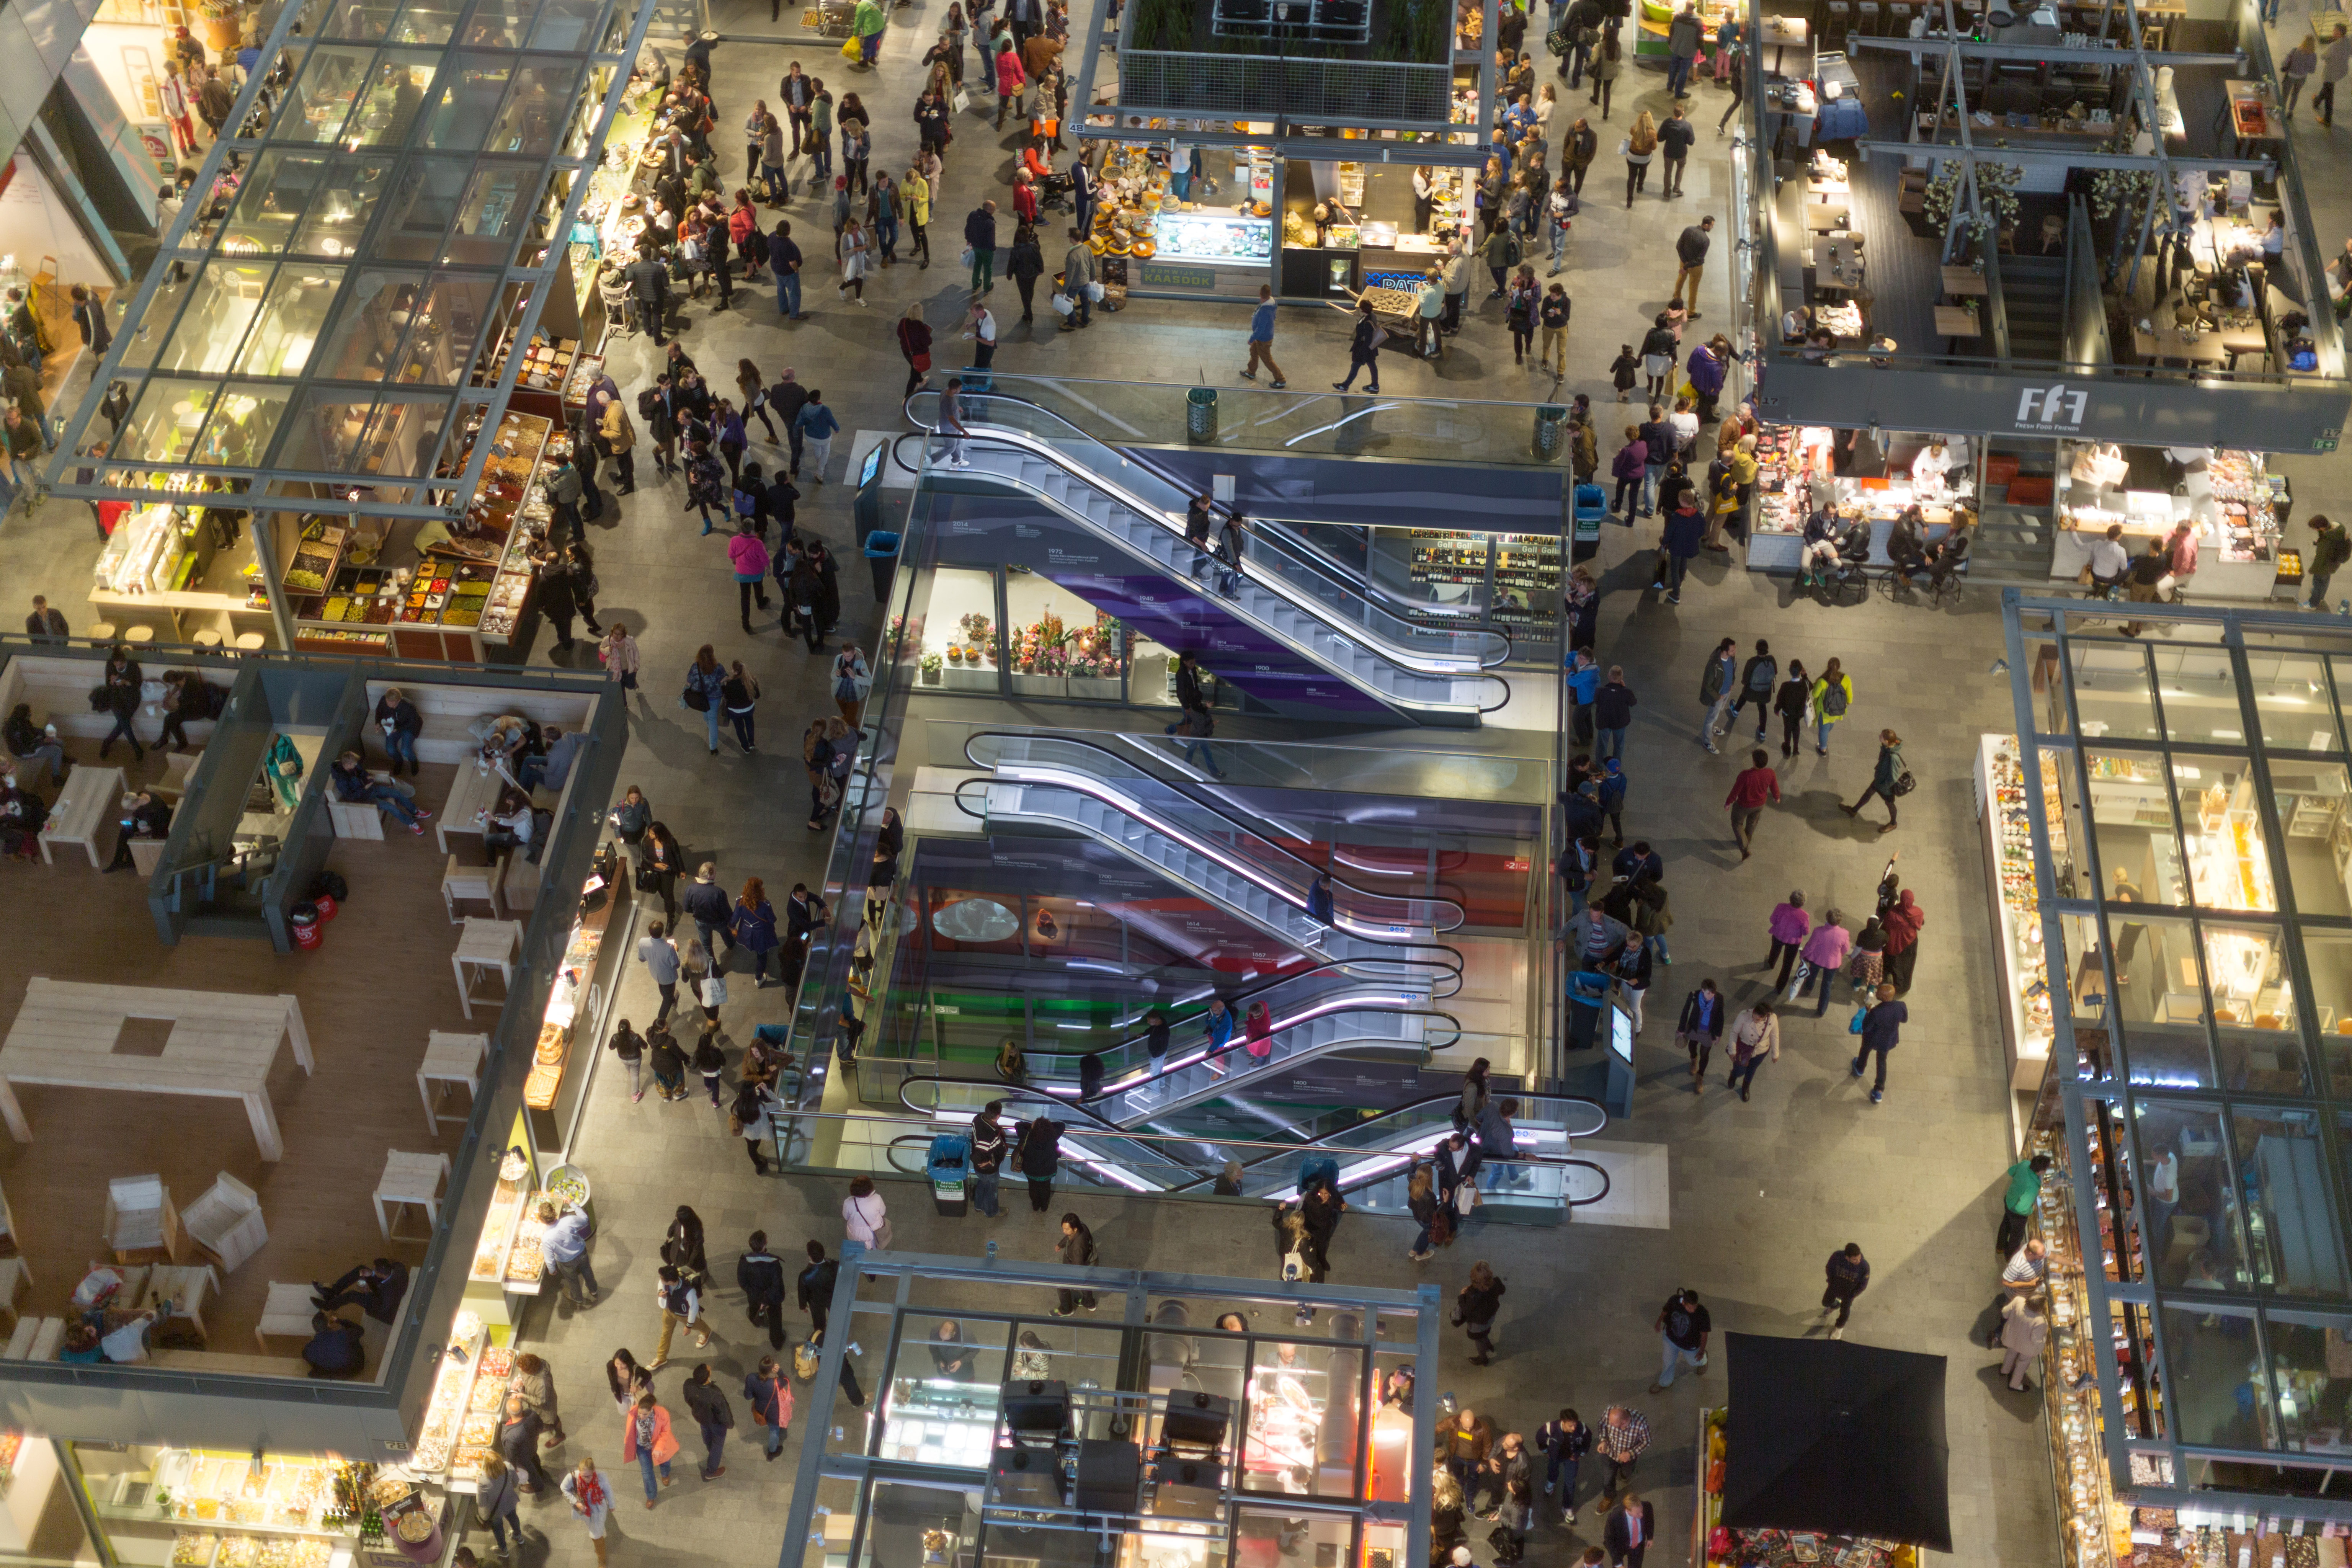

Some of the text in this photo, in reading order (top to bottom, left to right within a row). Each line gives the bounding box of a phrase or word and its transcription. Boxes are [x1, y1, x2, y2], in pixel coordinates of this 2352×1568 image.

[1145, 268, 1194, 276] CROMWIJK
[1145, 274, 1210, 286] KAASDOK
[1383, 279, 1430, 294] PAT
[385, 1442, 407, 1450] 78
